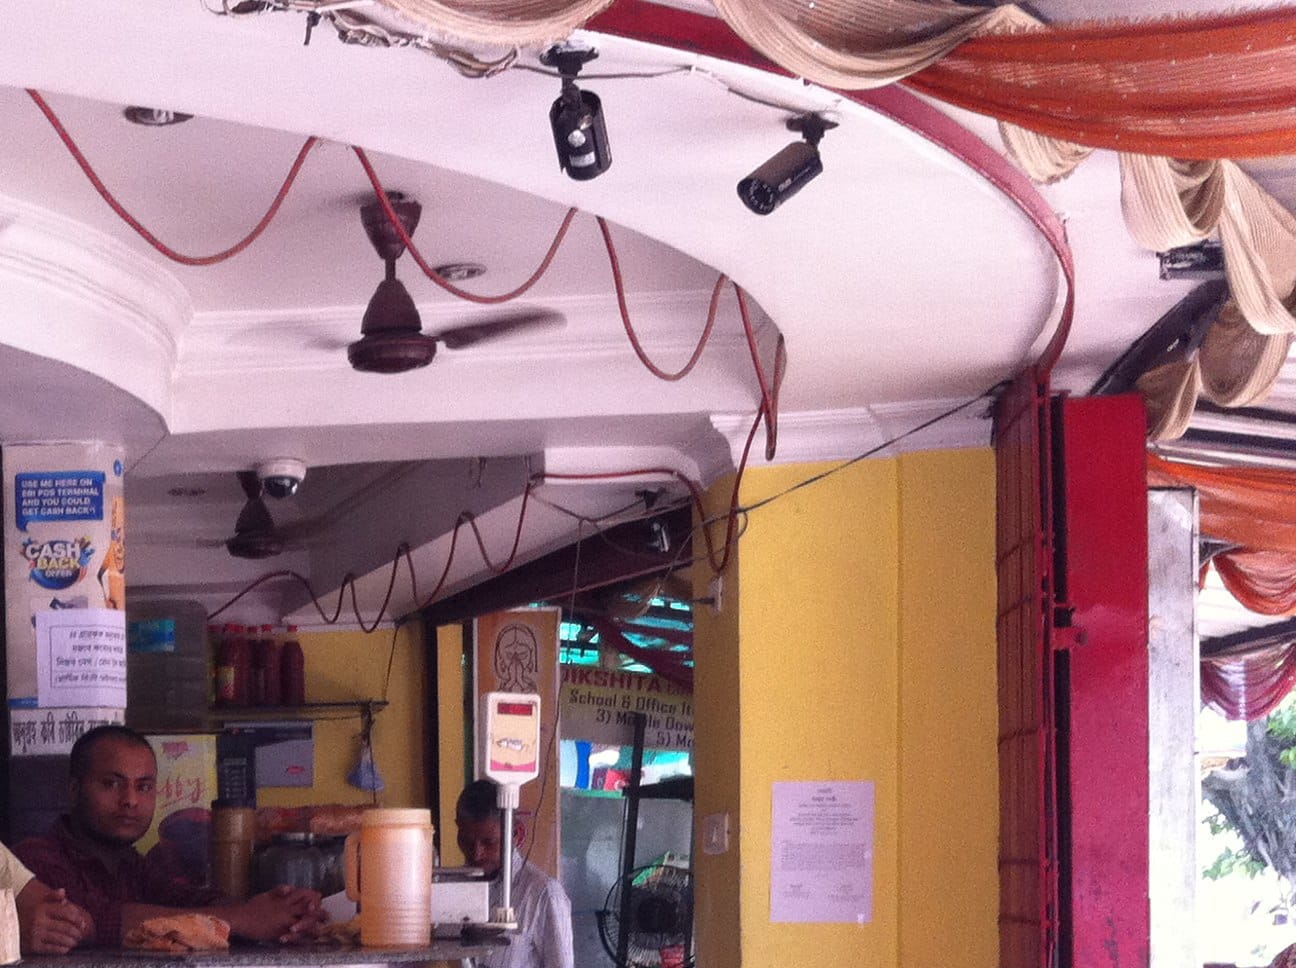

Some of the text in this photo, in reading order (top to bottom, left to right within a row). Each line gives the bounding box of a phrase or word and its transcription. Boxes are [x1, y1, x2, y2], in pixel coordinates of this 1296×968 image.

[78, 478, 92, 486] ON
[58, 487, 99, 496] TERMINAL
[42, 498, 59, 506] YOU
[22, 507, 38, 515] GET
[40, 506, 63, 515] CASH
[25, 543, 80, 559] CASH
[37, 558, 80, 570] BACK
[569, 688, 617, 706] School
[622, 695, 631, 709] &
[682, 702, 694, 716] It
[596, 709, 611, 724] 3)
